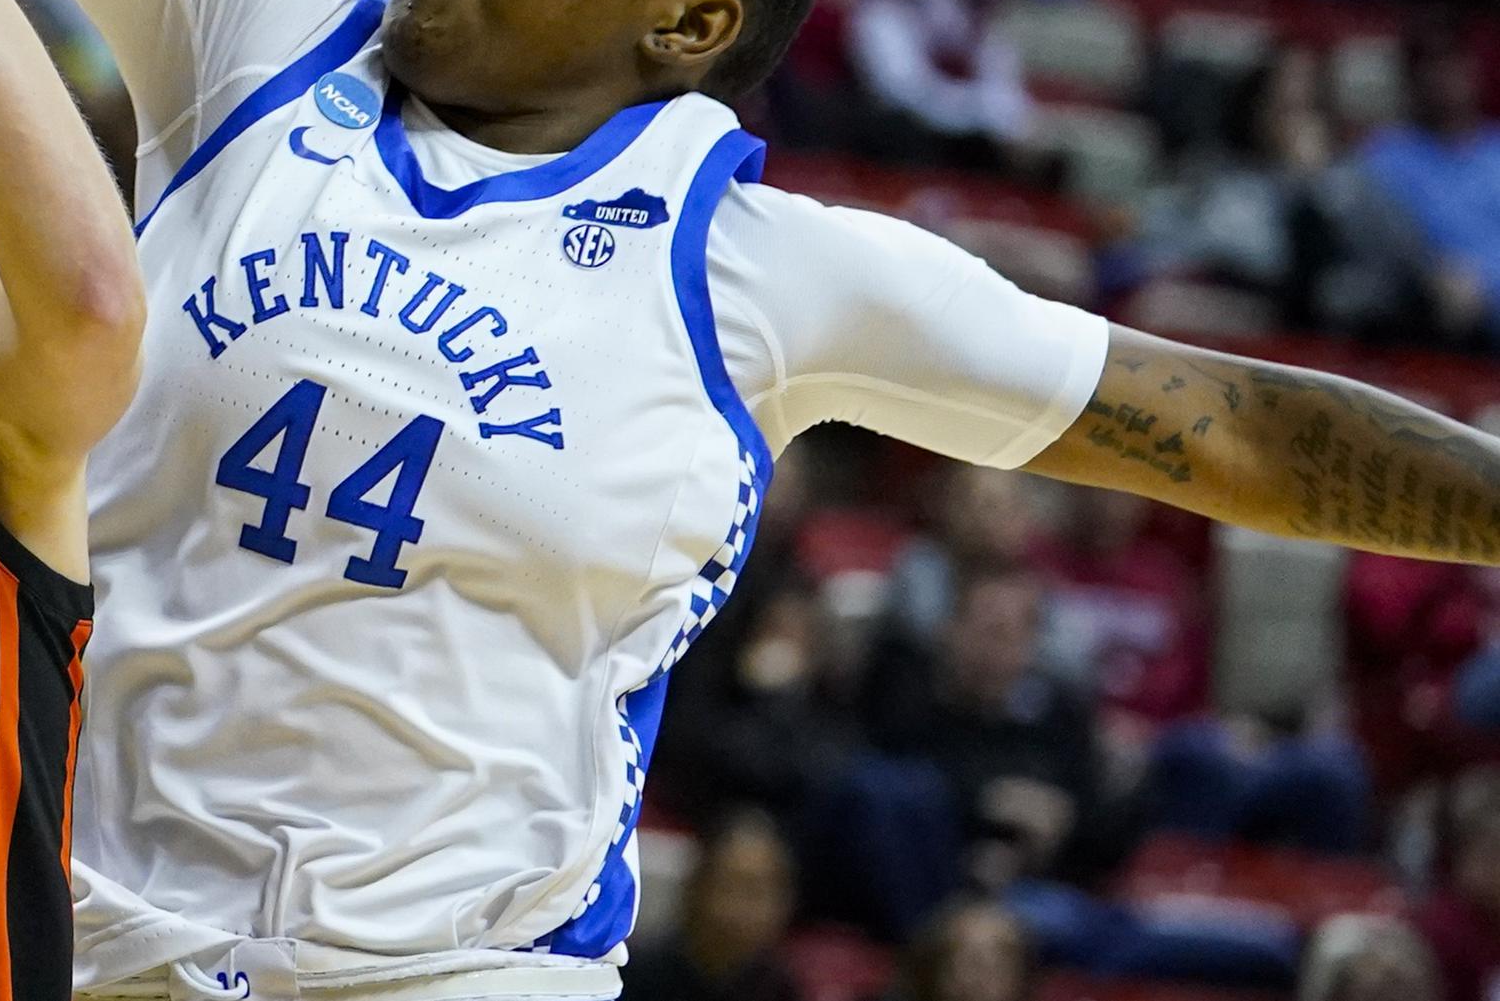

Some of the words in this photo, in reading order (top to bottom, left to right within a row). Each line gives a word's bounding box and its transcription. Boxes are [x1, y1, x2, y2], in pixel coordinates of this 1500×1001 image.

[320, 83, 371, 126] NCAA
[595, 206, 649, 225] UNITED
[564, 224, 615, 267] SEC
[182, 231, 565, 450] KENTUCKY
[215, 378, 446, 589] 44
